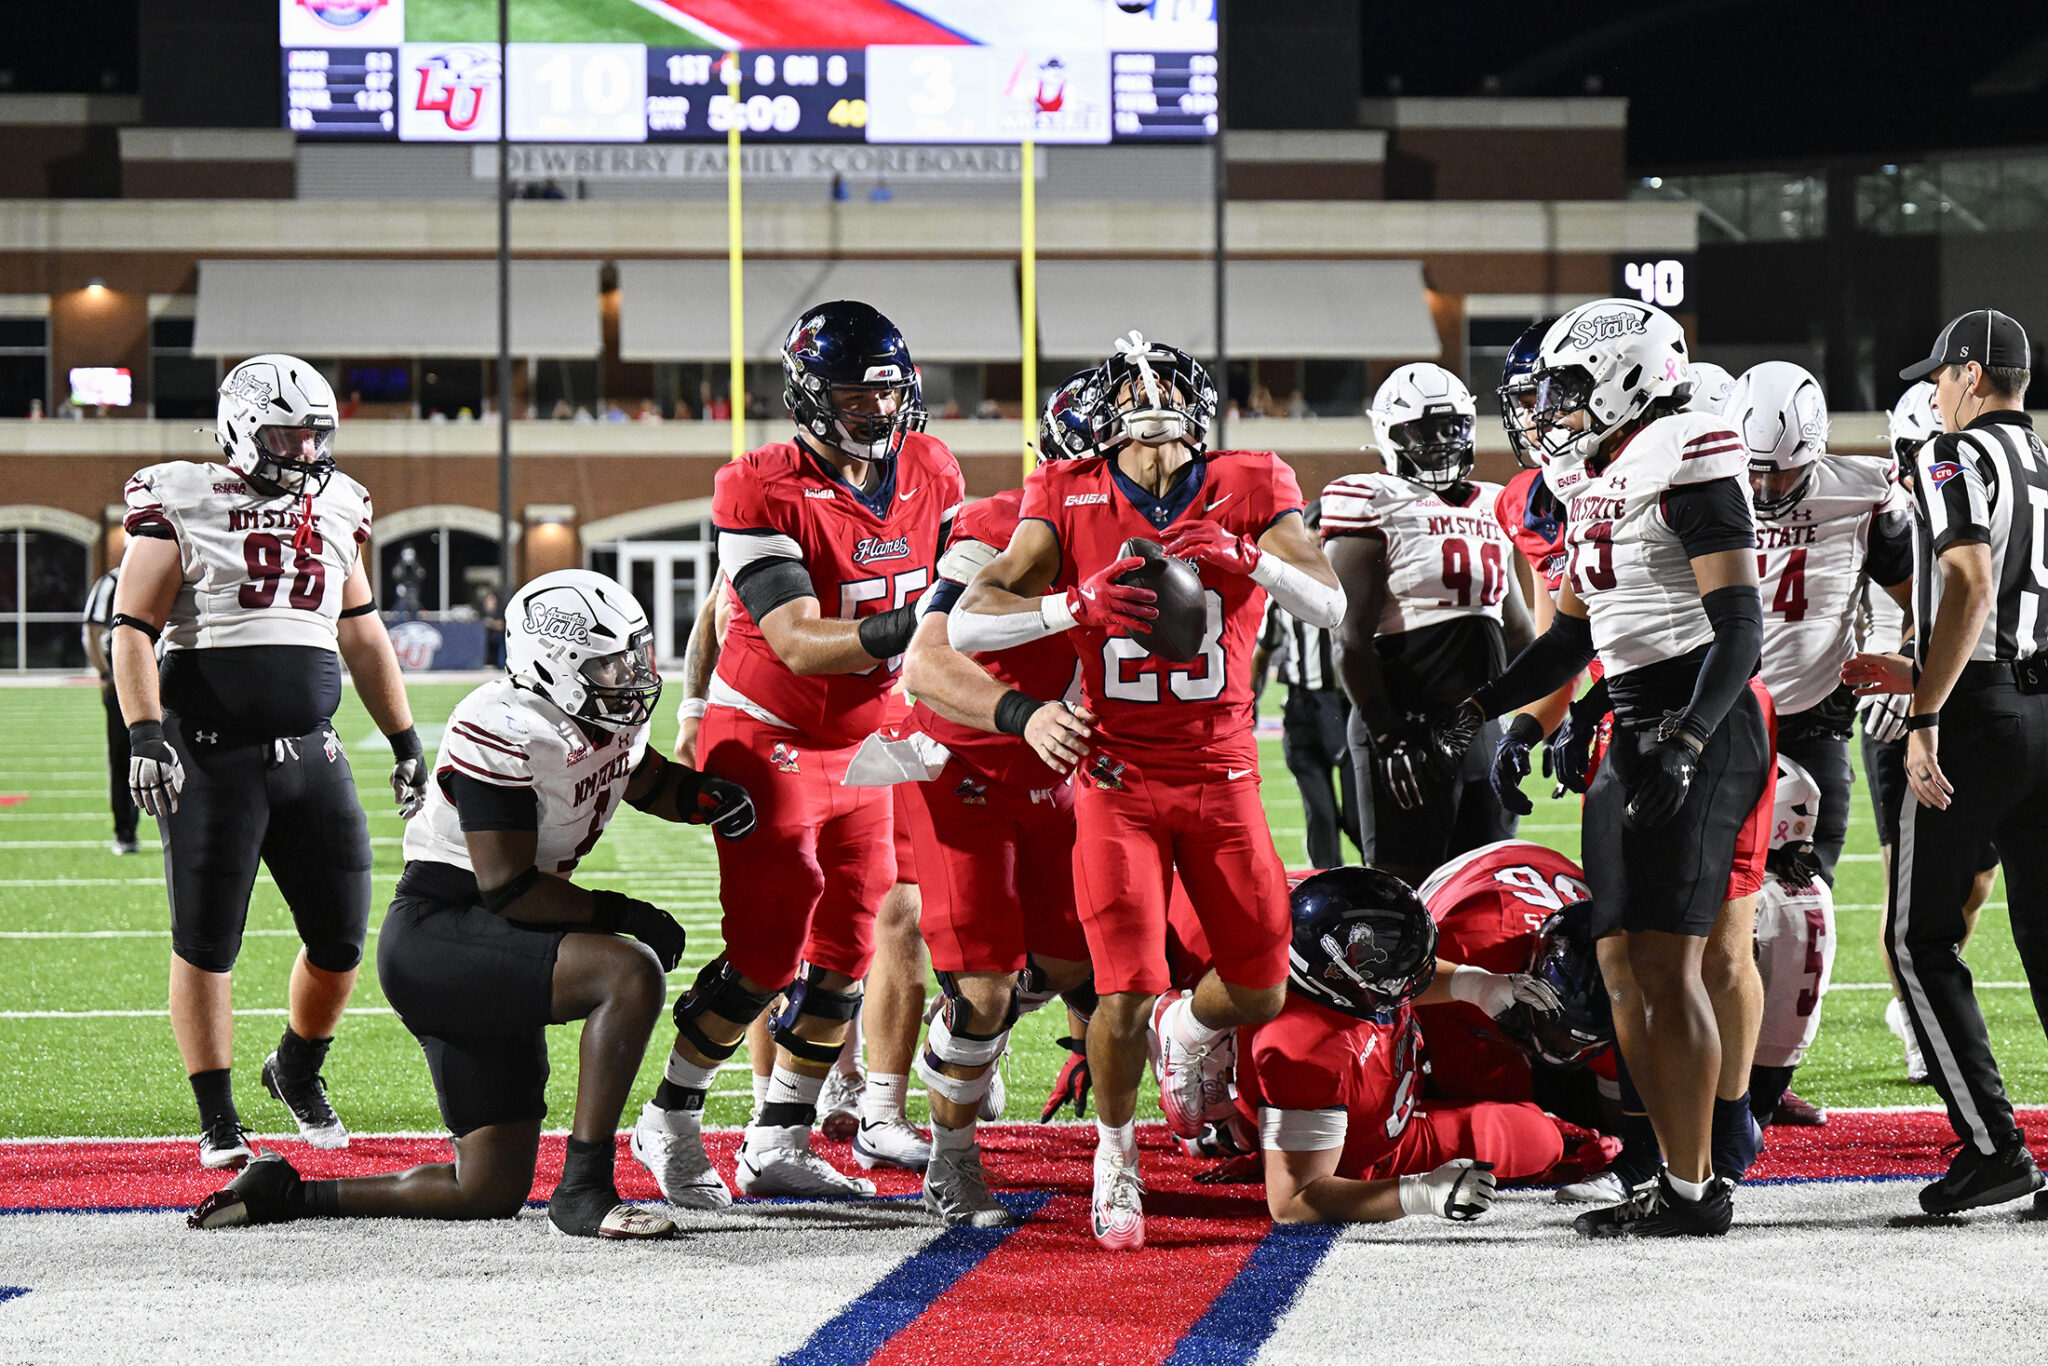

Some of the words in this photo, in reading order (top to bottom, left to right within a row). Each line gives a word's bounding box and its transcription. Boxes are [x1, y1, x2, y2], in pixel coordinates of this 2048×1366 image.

[535, 55, 633, 114] 10
[667, 56, 712, 84] 1ST
[907, 55, 957, 115] 3
[415, 66, 490, 131] LU
[1624, 260, 1684, 307] 40
[1572, 312, 1647, 350] State
[1959, 345, 1970, 358] S
[227, 370, 272, 410] State
[1936, 469, 1953, 479] CFO
[227, 509, 259, 532] NM
[262, 509, 322, 531] STATE
[1427, 515, 1455, 536] NM
[1580, 495, 1627, 521] STATE
[853, 536, 911, 565] Flames
[1756, 523, 1818, 550] STATE
[237, 532, 326, 612] 96
[1441, 537, 1506, 608] 90
[1567, 520, 1618, 595] 13
[522, 602, 589, 645] State
[1102, 586, 1227, 704] 23
[573, 771, 598, 808] NM
[1796, 908, 1827, 1017] 5
